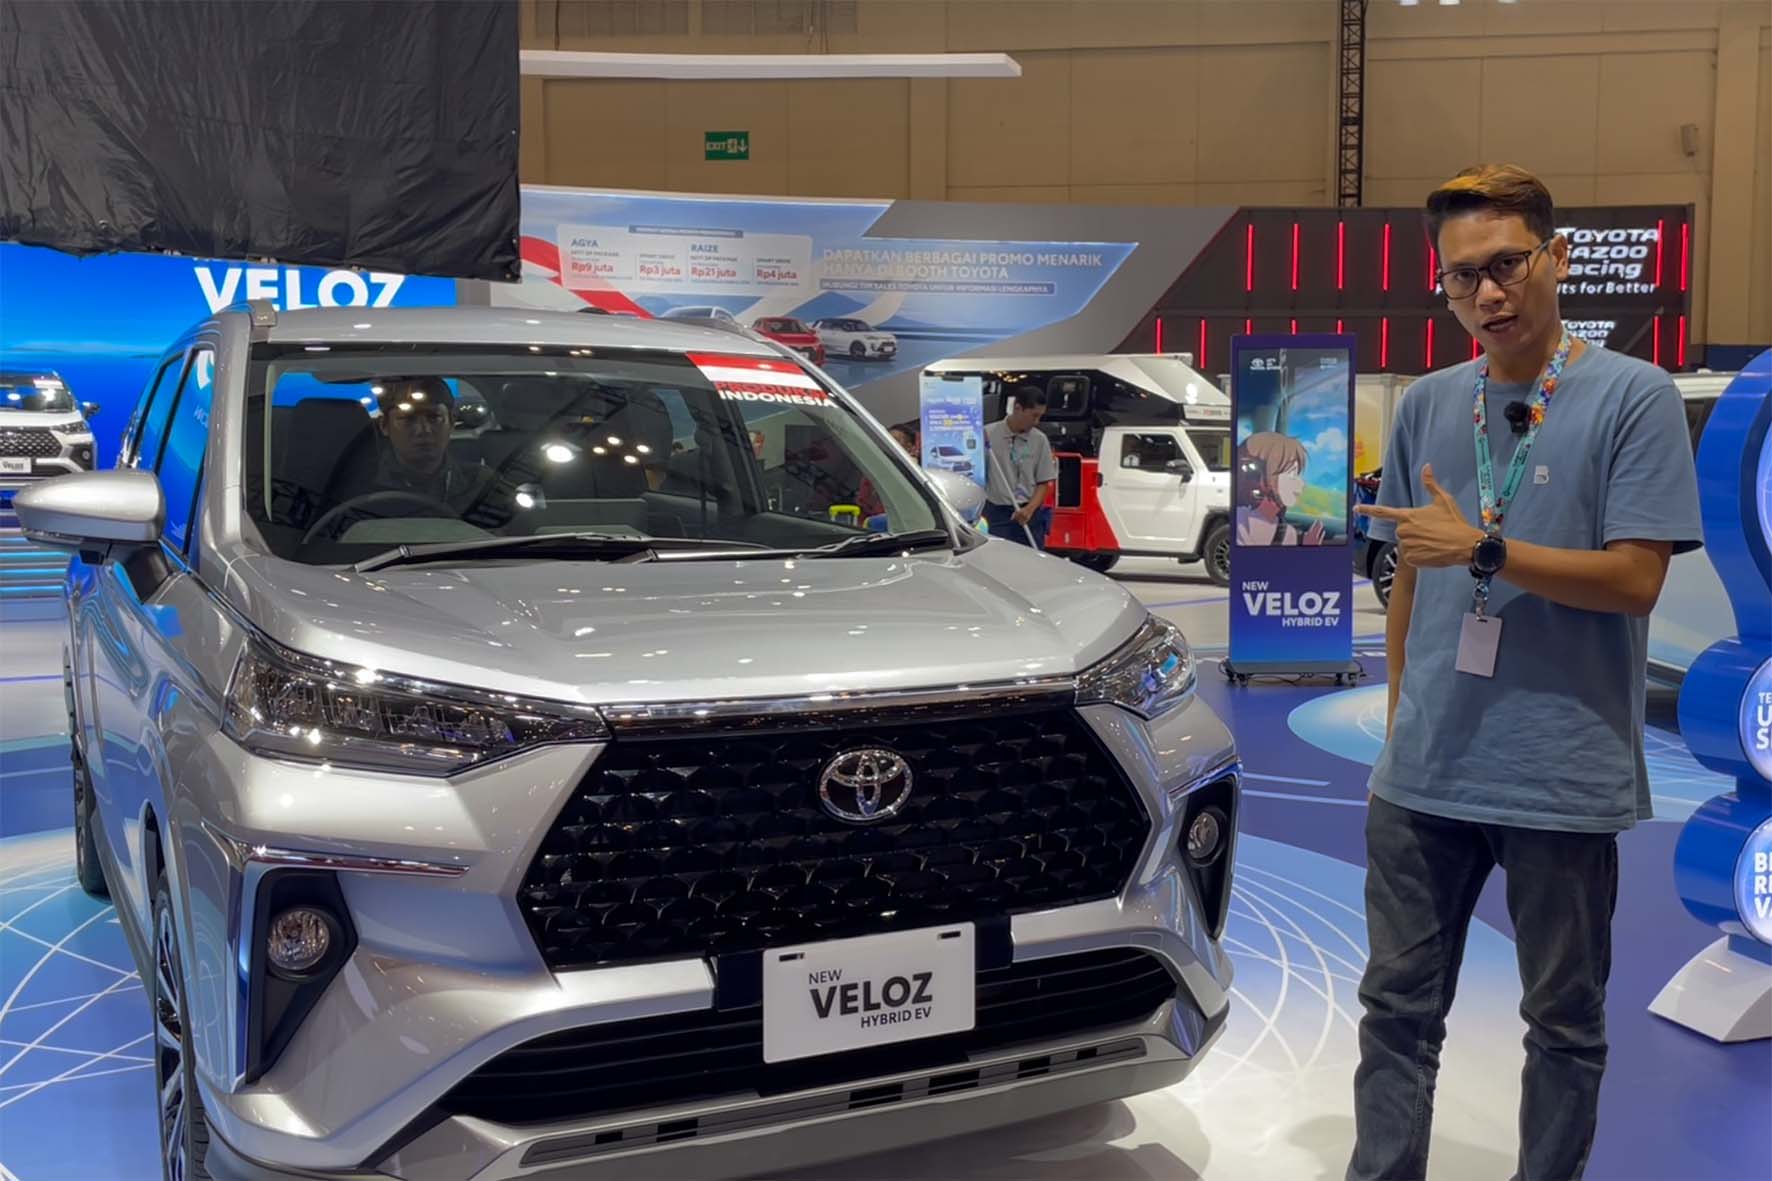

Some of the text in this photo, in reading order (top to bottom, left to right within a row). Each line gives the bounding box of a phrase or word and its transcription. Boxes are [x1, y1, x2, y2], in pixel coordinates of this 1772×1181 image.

[1554, 228, 1659, 243] TOYOTA
[571, 239, 599, 248] AGYA
[691, 244, 719, 253] RAIZE
[823, 248, 1103, 267] DAPATKAN BERBAGAI PROMO MENARIK
[571, 262, 614, 274] Rp9 juta
[639, 264, 681, 276] Rp3 juta
[716, 268, 737, 279] juta
[756, 269, 798, 281] Rp4 juta
[893, 265, 946, 278] BOOTH
[952, 265, 1009, 279] TOYOTA
[1568, 259, 1643, 279] acing
[194, 267, 405, 314] VELOZ
[1580, 282, 1604, 294] for
[1605, 281, 1656, 293] Better
[718, 390, 838, 409] INDONESIA
[1242, 581, 1269, 591] NEW
[1242, 591, 1341, 616] VELOZ
[1282, 617, 1339, 627] HYBRID EV
[808, 969, 842, 985] NEW
[809, 971, 933, 1019] VELOZ
[860, 1007, 932, 1028] HYBRID EV
